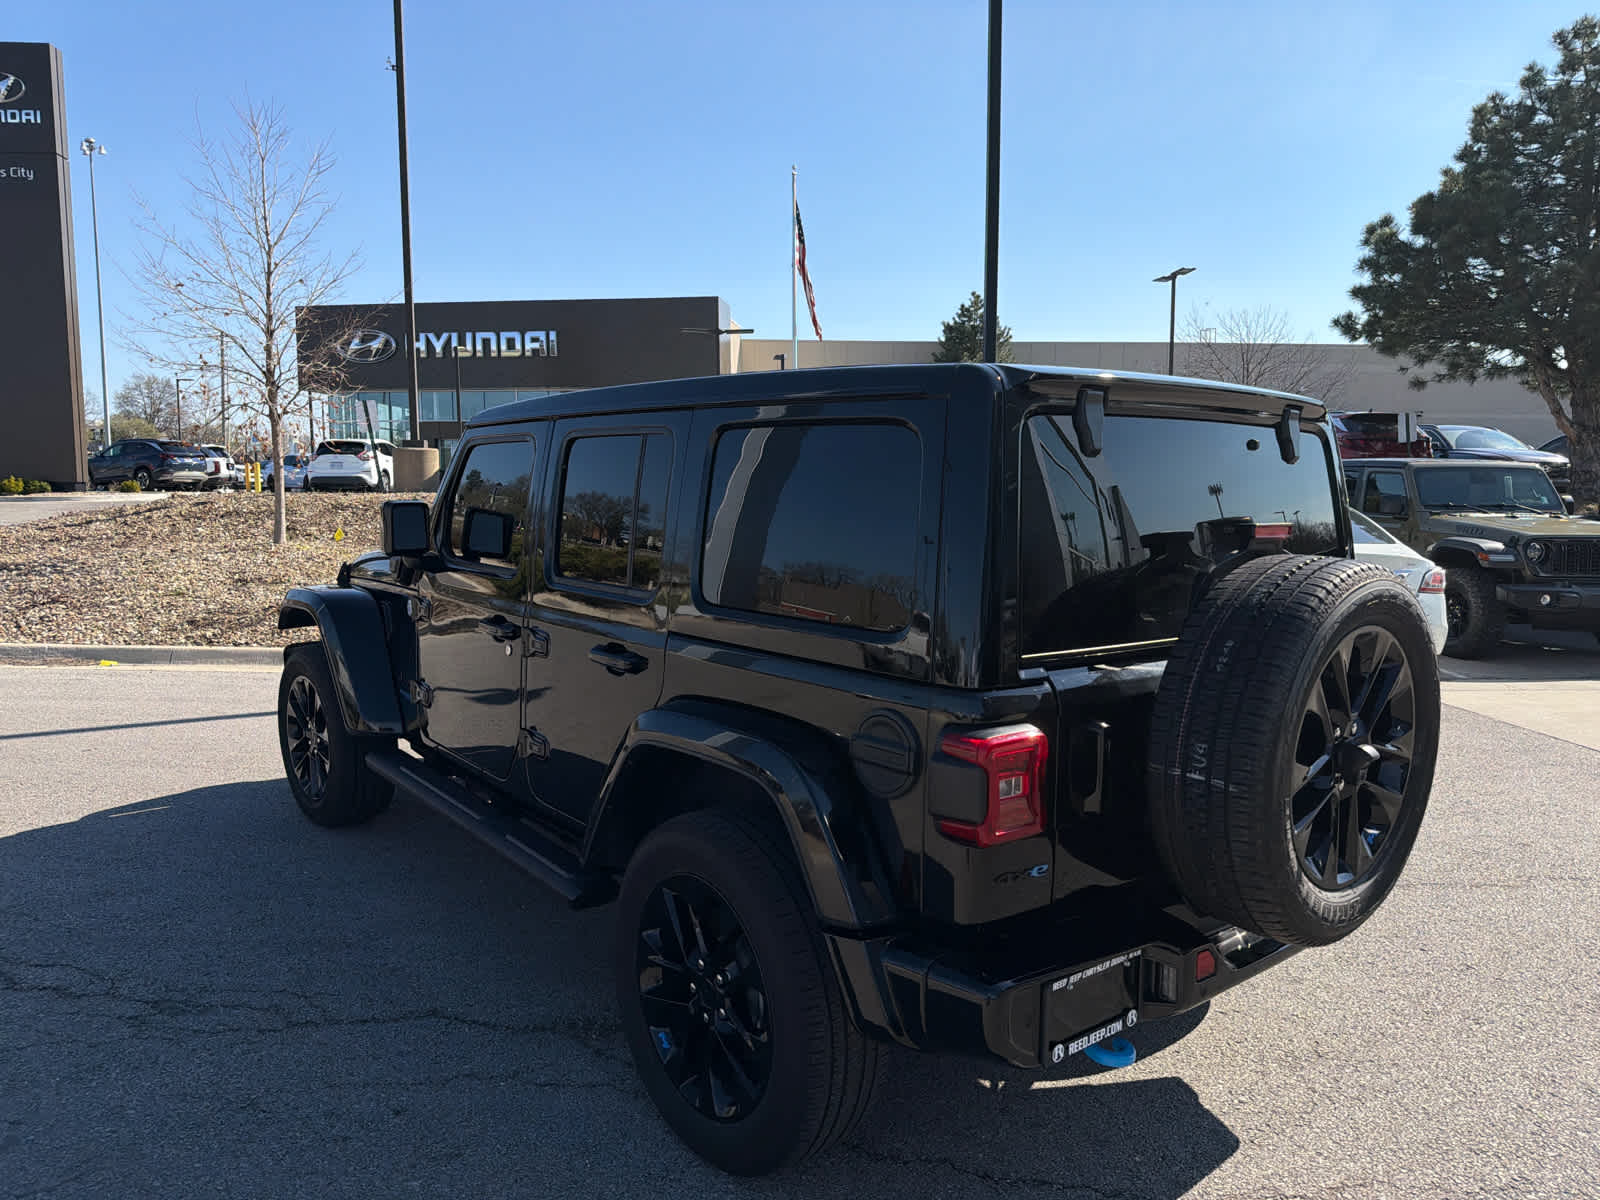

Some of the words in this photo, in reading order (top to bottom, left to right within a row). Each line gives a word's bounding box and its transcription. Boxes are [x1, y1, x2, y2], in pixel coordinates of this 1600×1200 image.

[10, 167, 34, 181] City
[404, 330, 558, 358] HYUNDAI
[1068, 1019, 1124, 1056] REEDJEEP.COM
